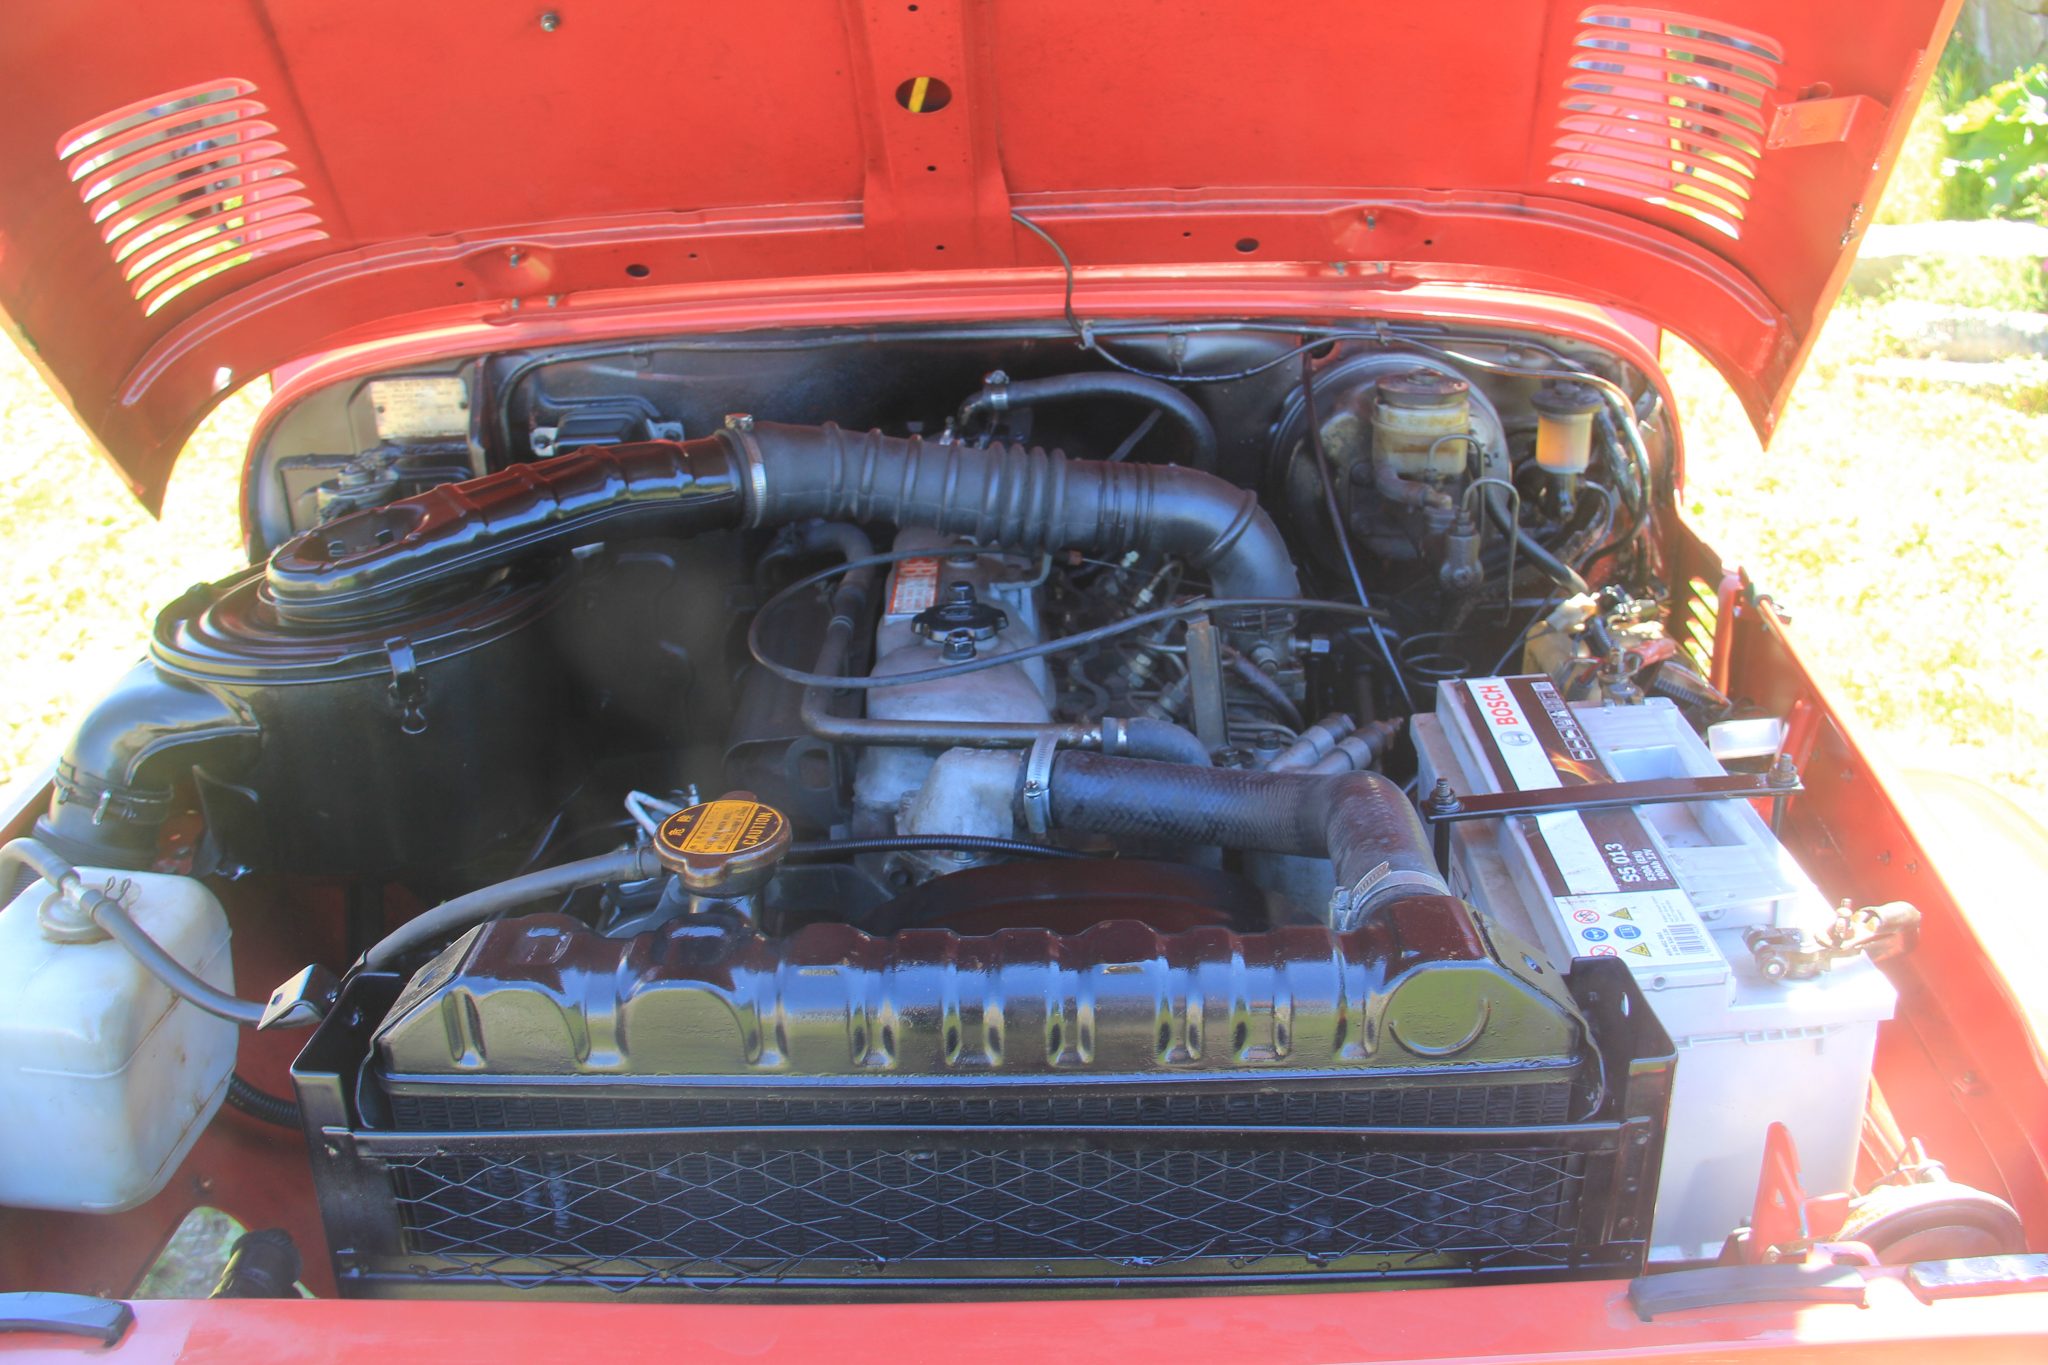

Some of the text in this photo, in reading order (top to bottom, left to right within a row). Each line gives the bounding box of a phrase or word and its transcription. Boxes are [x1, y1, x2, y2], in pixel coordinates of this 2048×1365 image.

[1478, 685, 1519, 725] BOSCH
[742, 812, 773, 846] CAUTION
[1604, 843, 1641, 882] S5 013
[1642, 848, 1657, 860] 12V
[1650, 860, 1670, 880] 100Ah
